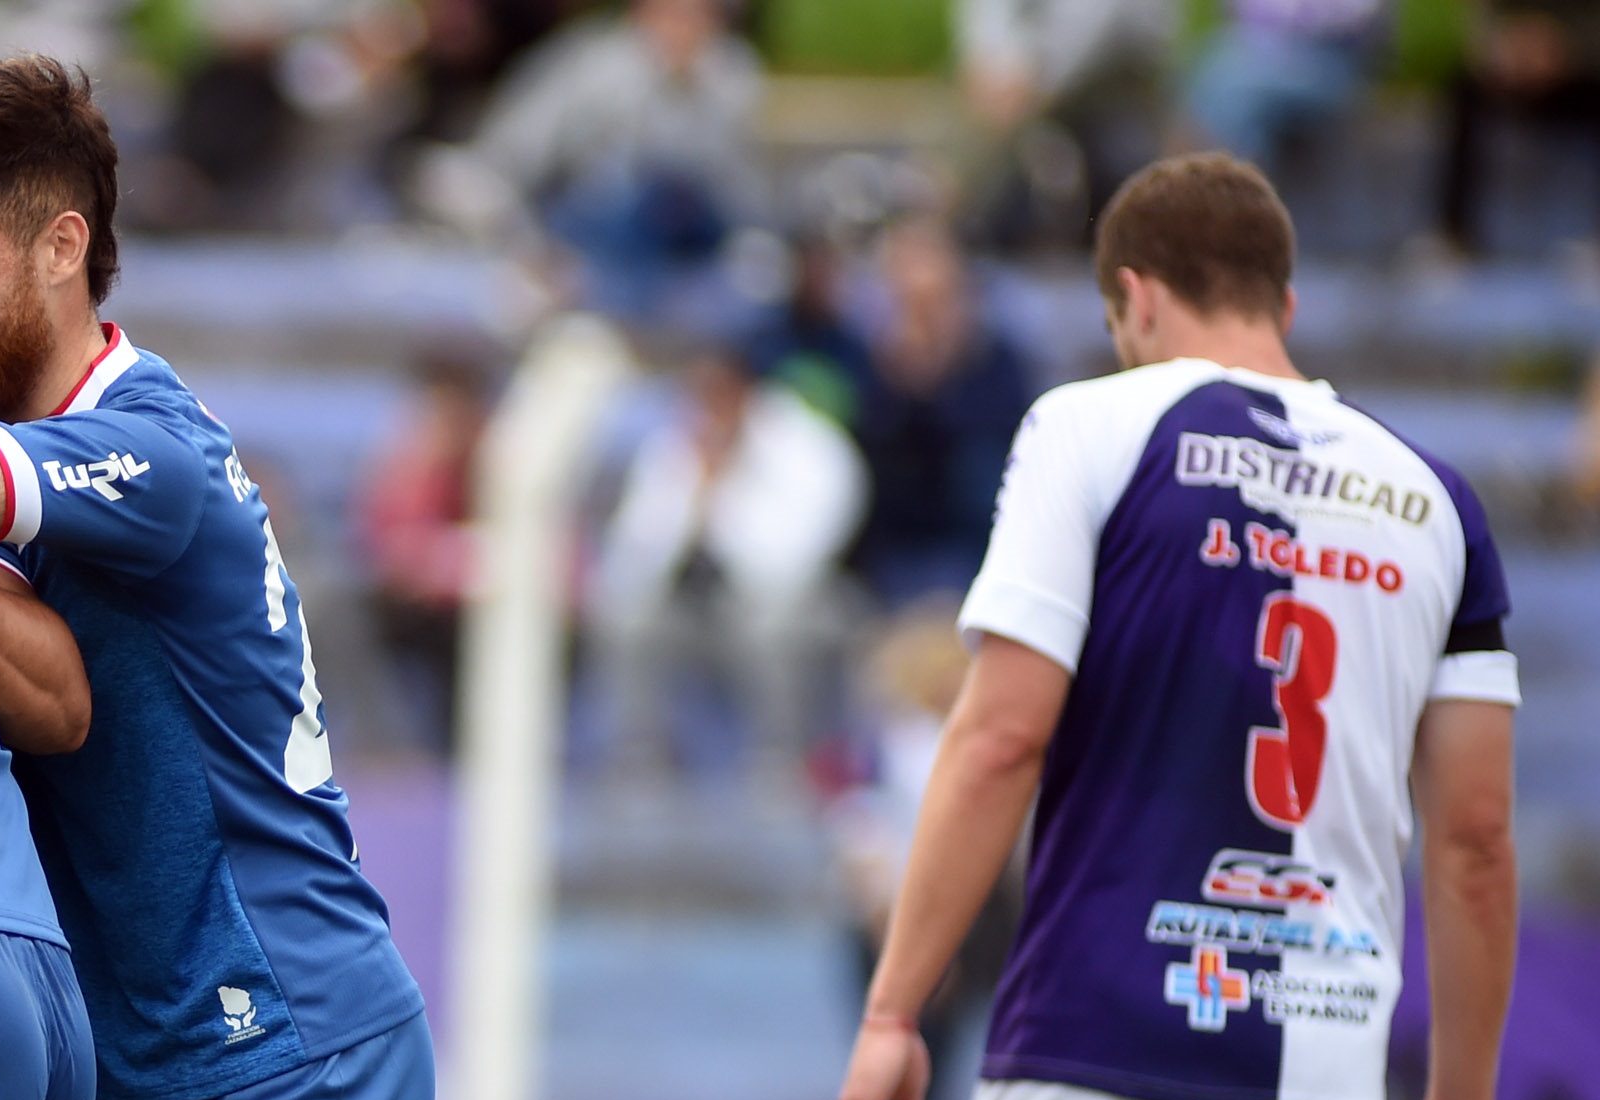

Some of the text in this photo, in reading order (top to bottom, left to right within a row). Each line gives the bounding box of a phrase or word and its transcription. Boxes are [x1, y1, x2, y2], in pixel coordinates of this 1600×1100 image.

[1181, 439, 1432, 527] DISTRICAD
[1206, 523, 1404, 594] J. TOLEDO
[1250, 594, 1338, 829] 3
